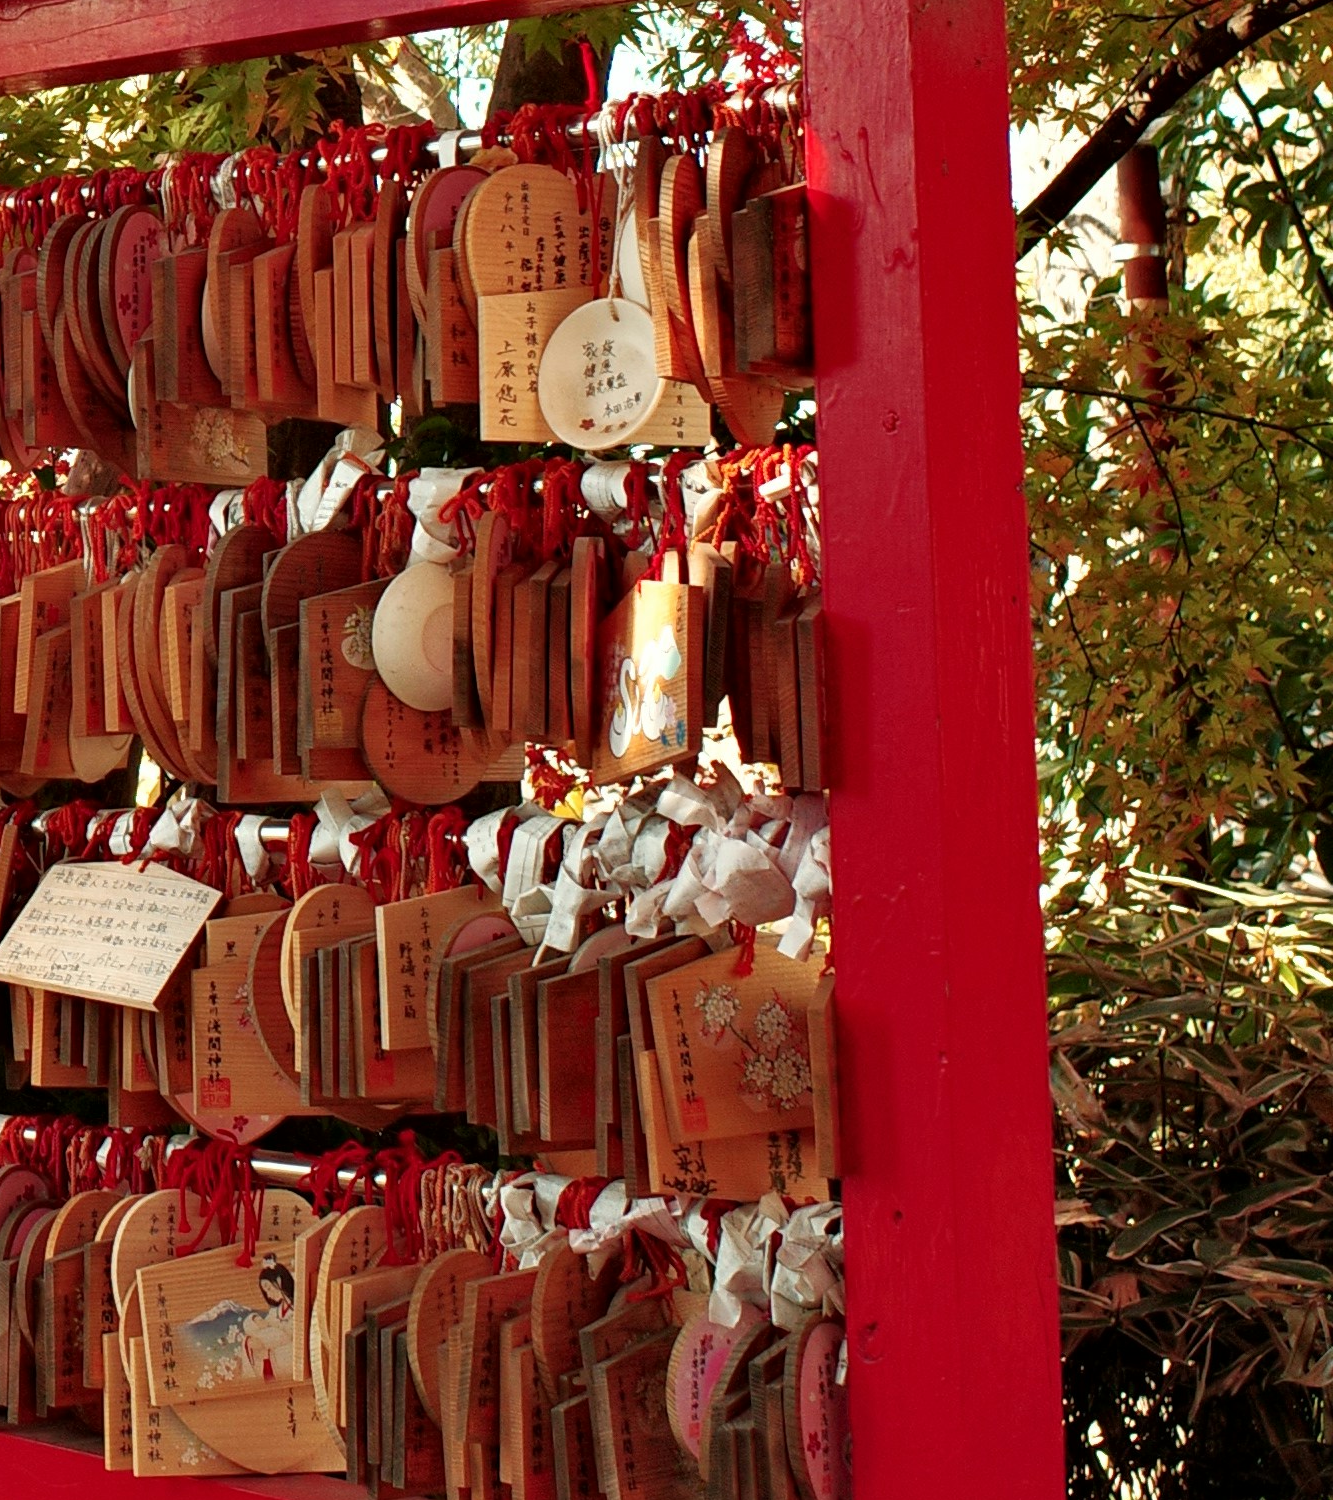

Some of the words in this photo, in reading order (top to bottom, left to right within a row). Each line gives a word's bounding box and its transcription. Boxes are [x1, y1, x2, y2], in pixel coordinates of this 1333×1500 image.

[319, 609, 335, 715] 多摩川浅間神社
[206, 980, 222, 1084] 多摩川浅間神社
[155, 1281, 181, 1392] 多摩川浅間神社
